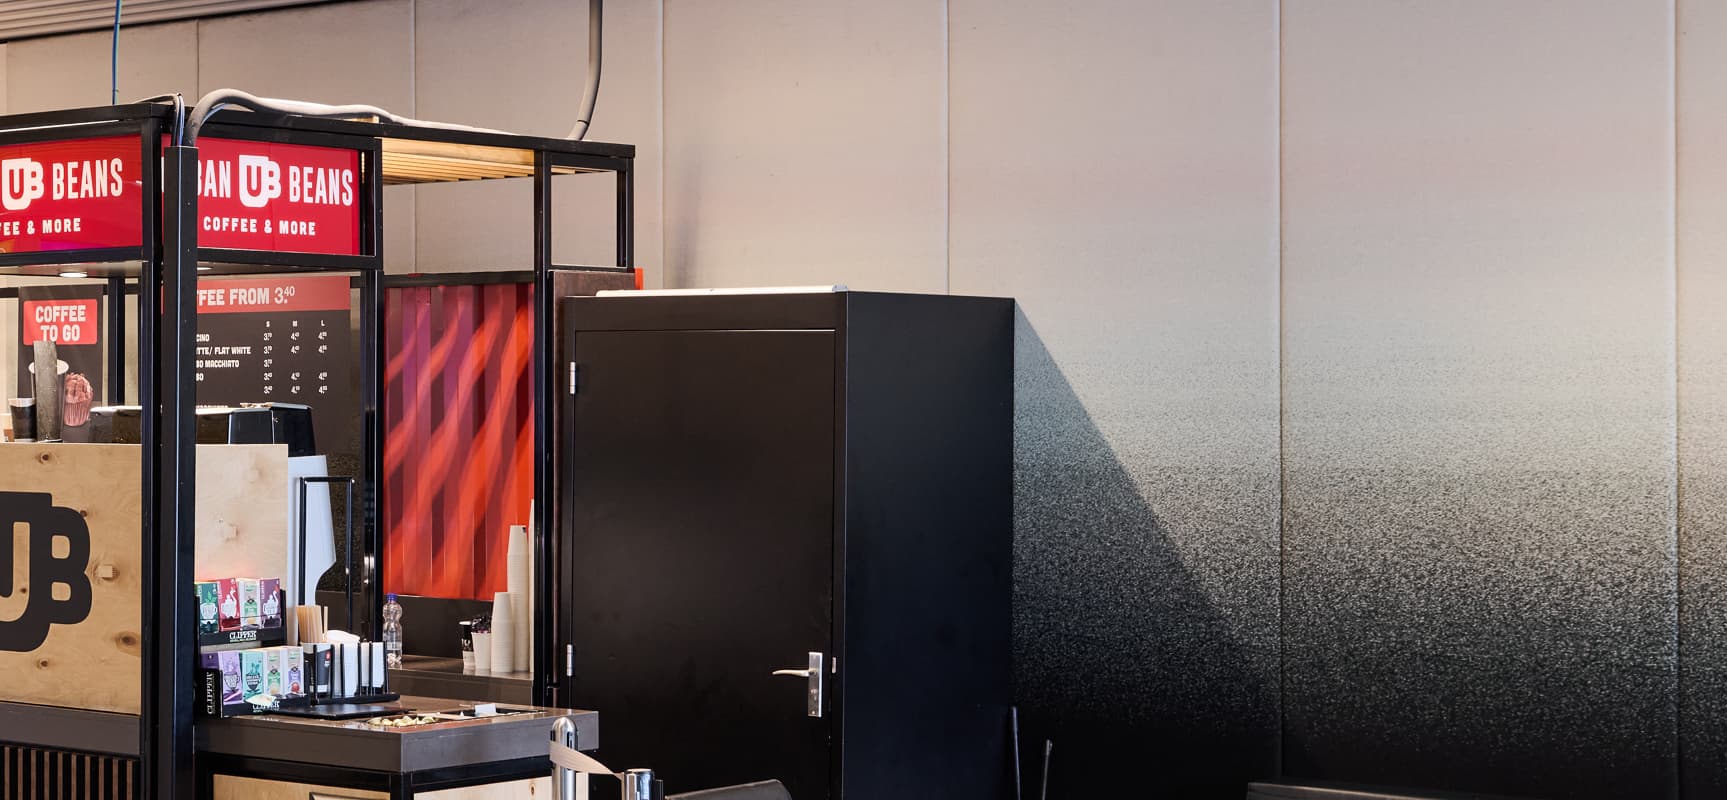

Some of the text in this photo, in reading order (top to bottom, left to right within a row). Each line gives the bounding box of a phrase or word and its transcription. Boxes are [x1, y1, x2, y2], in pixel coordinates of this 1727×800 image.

[52, 158, 123, 201] BEANS
[289, 165, 353, 206] BEANS
[27, 220, 35, 235] &
[42, 218, 81, 234] MORE
[203, 216, 315, 235] COFFEE & MORE
[197, 288, 225, 306] FEE
[229, 287, 270, 305] FROM
[35, 304, 87, 323] COFFEE
[40, 324, 80, 342] TO GO
[214, 346, 230, 356] FLAT
[231, 346, 252, 355] WHITE
[204, 359, 240, 368] MACCHIATO
[229, 630, 257, 640] CLIPPER
